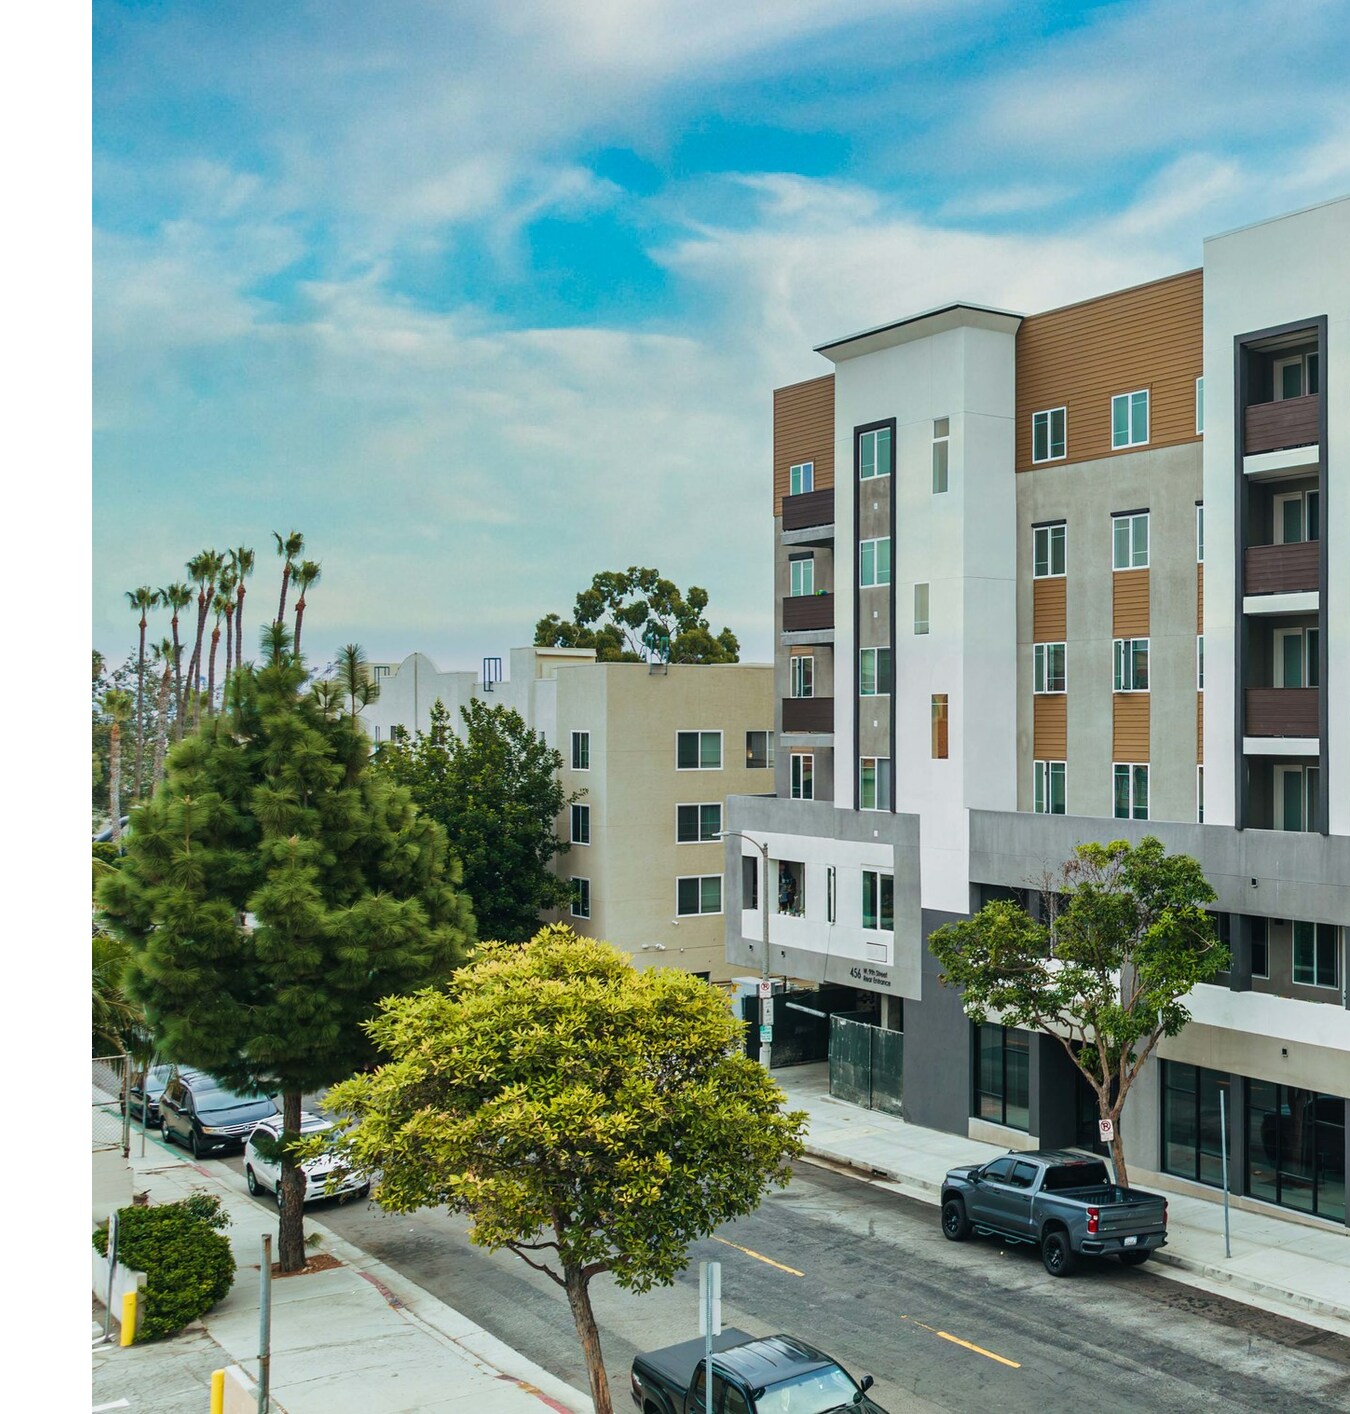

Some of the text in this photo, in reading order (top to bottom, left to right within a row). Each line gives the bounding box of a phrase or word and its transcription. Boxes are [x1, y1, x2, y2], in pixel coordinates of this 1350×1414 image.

[849, 967, 862, 979] 456
[875, 970, 888, 978] Street
[863, 975, 891, 987] Rear Entrance
